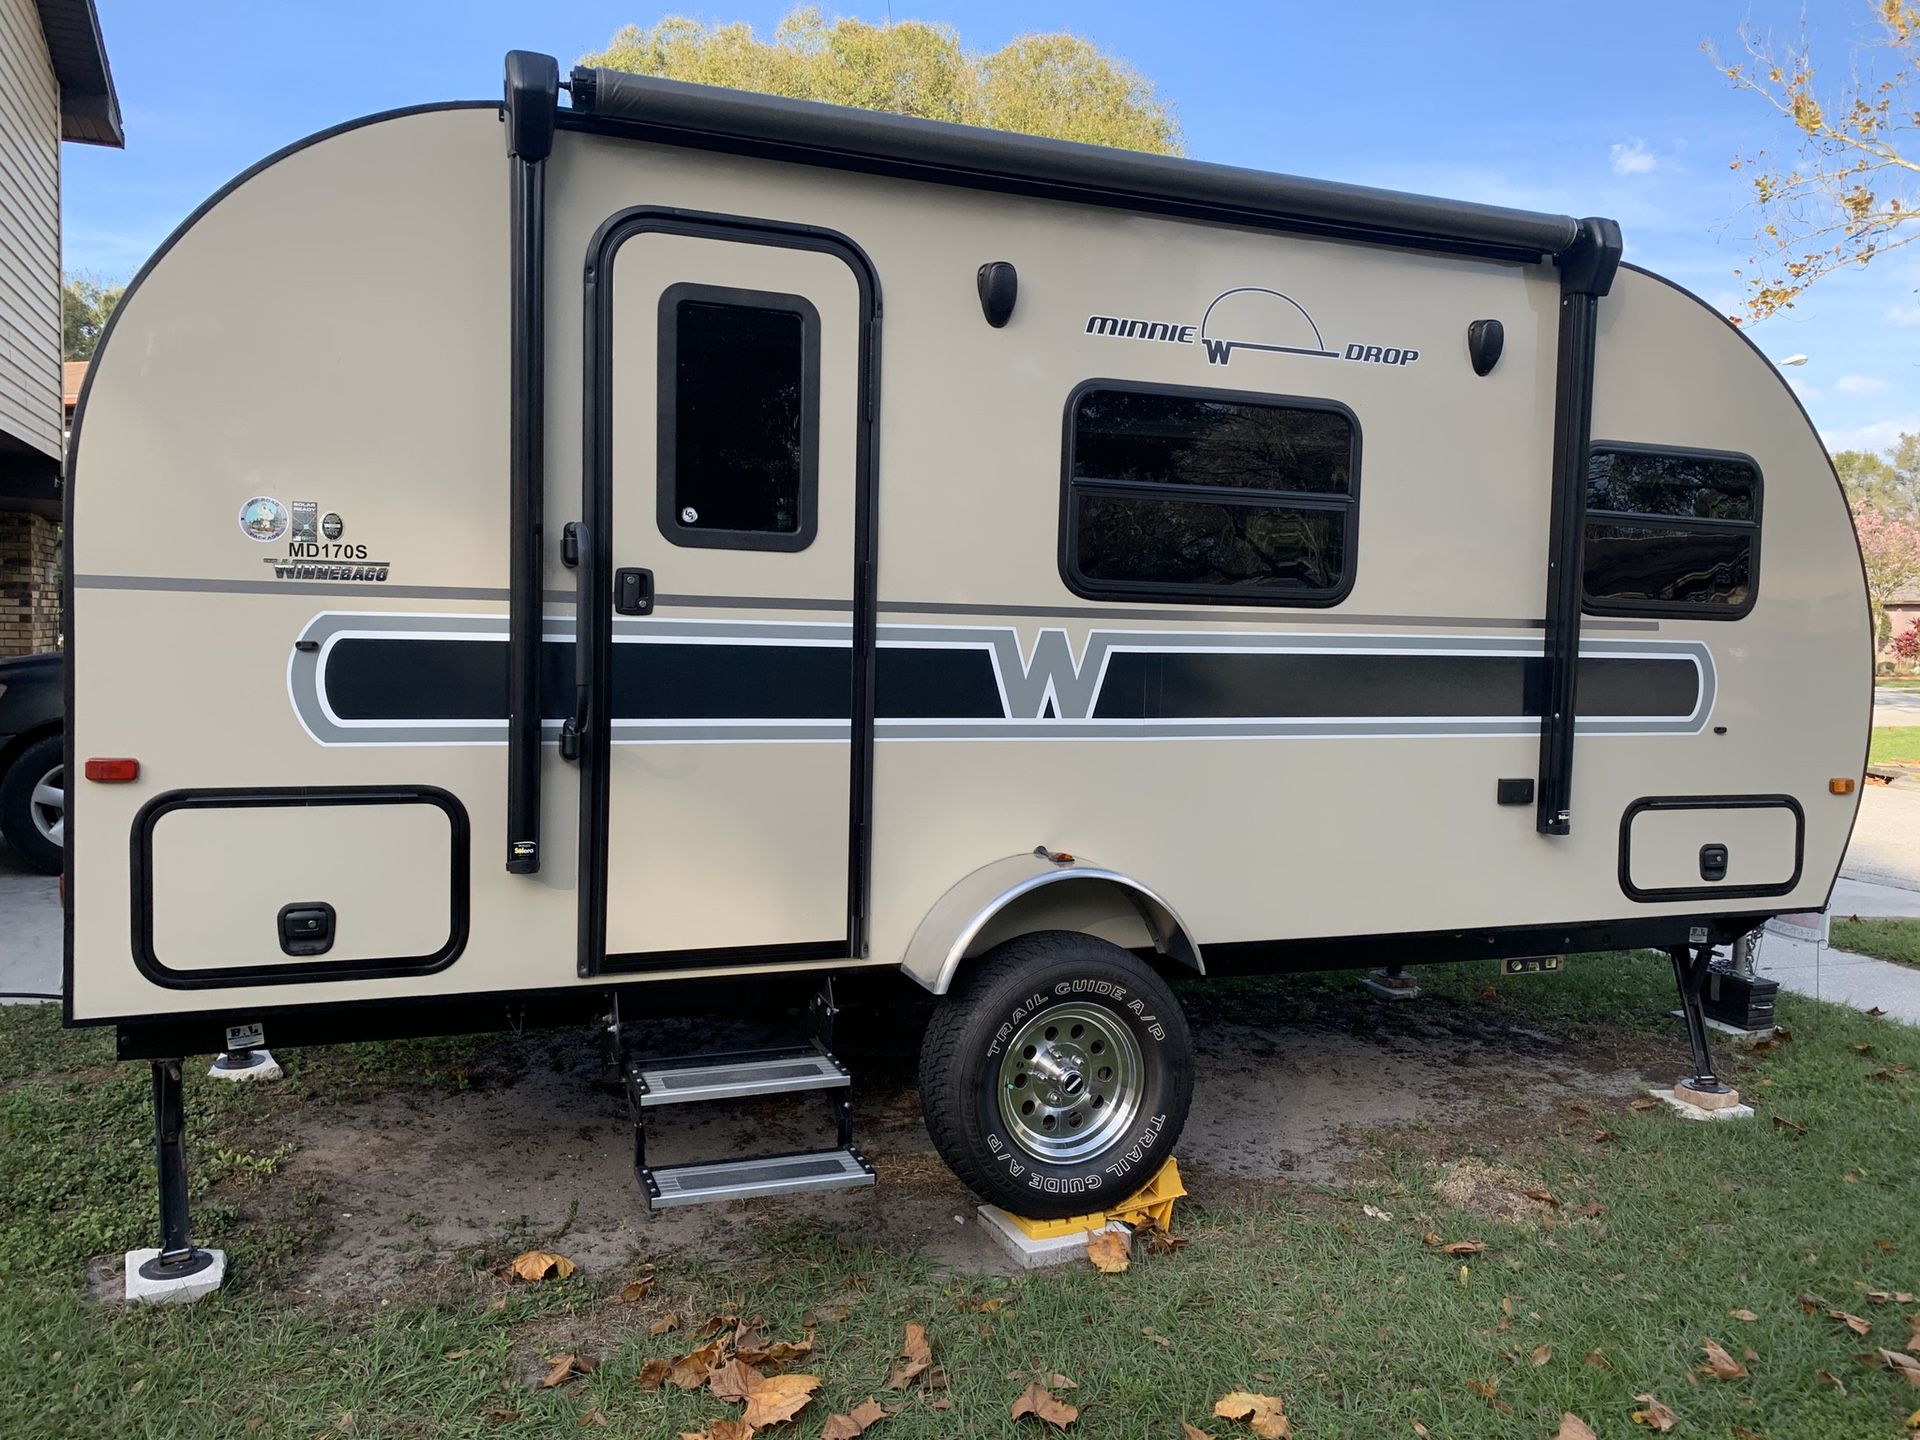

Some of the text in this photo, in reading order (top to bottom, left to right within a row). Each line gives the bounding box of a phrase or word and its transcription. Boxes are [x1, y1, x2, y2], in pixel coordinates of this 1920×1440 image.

[1086, 315, 1198, 344] MINNIE
[1344, 343, 1420, 366] DROP
[249, 531, 281, 540] PACKAGE
[289, 542, 368, 559] MD170S
[273, 558, 390, 582] WINNEBAGO
[990, 627, 1110, 719] W
[987, 979, 1166, 1059] TRAIL GUIDE A/P
[987, 1114, 1166, 1194] TRAIL GUIDE A/P
